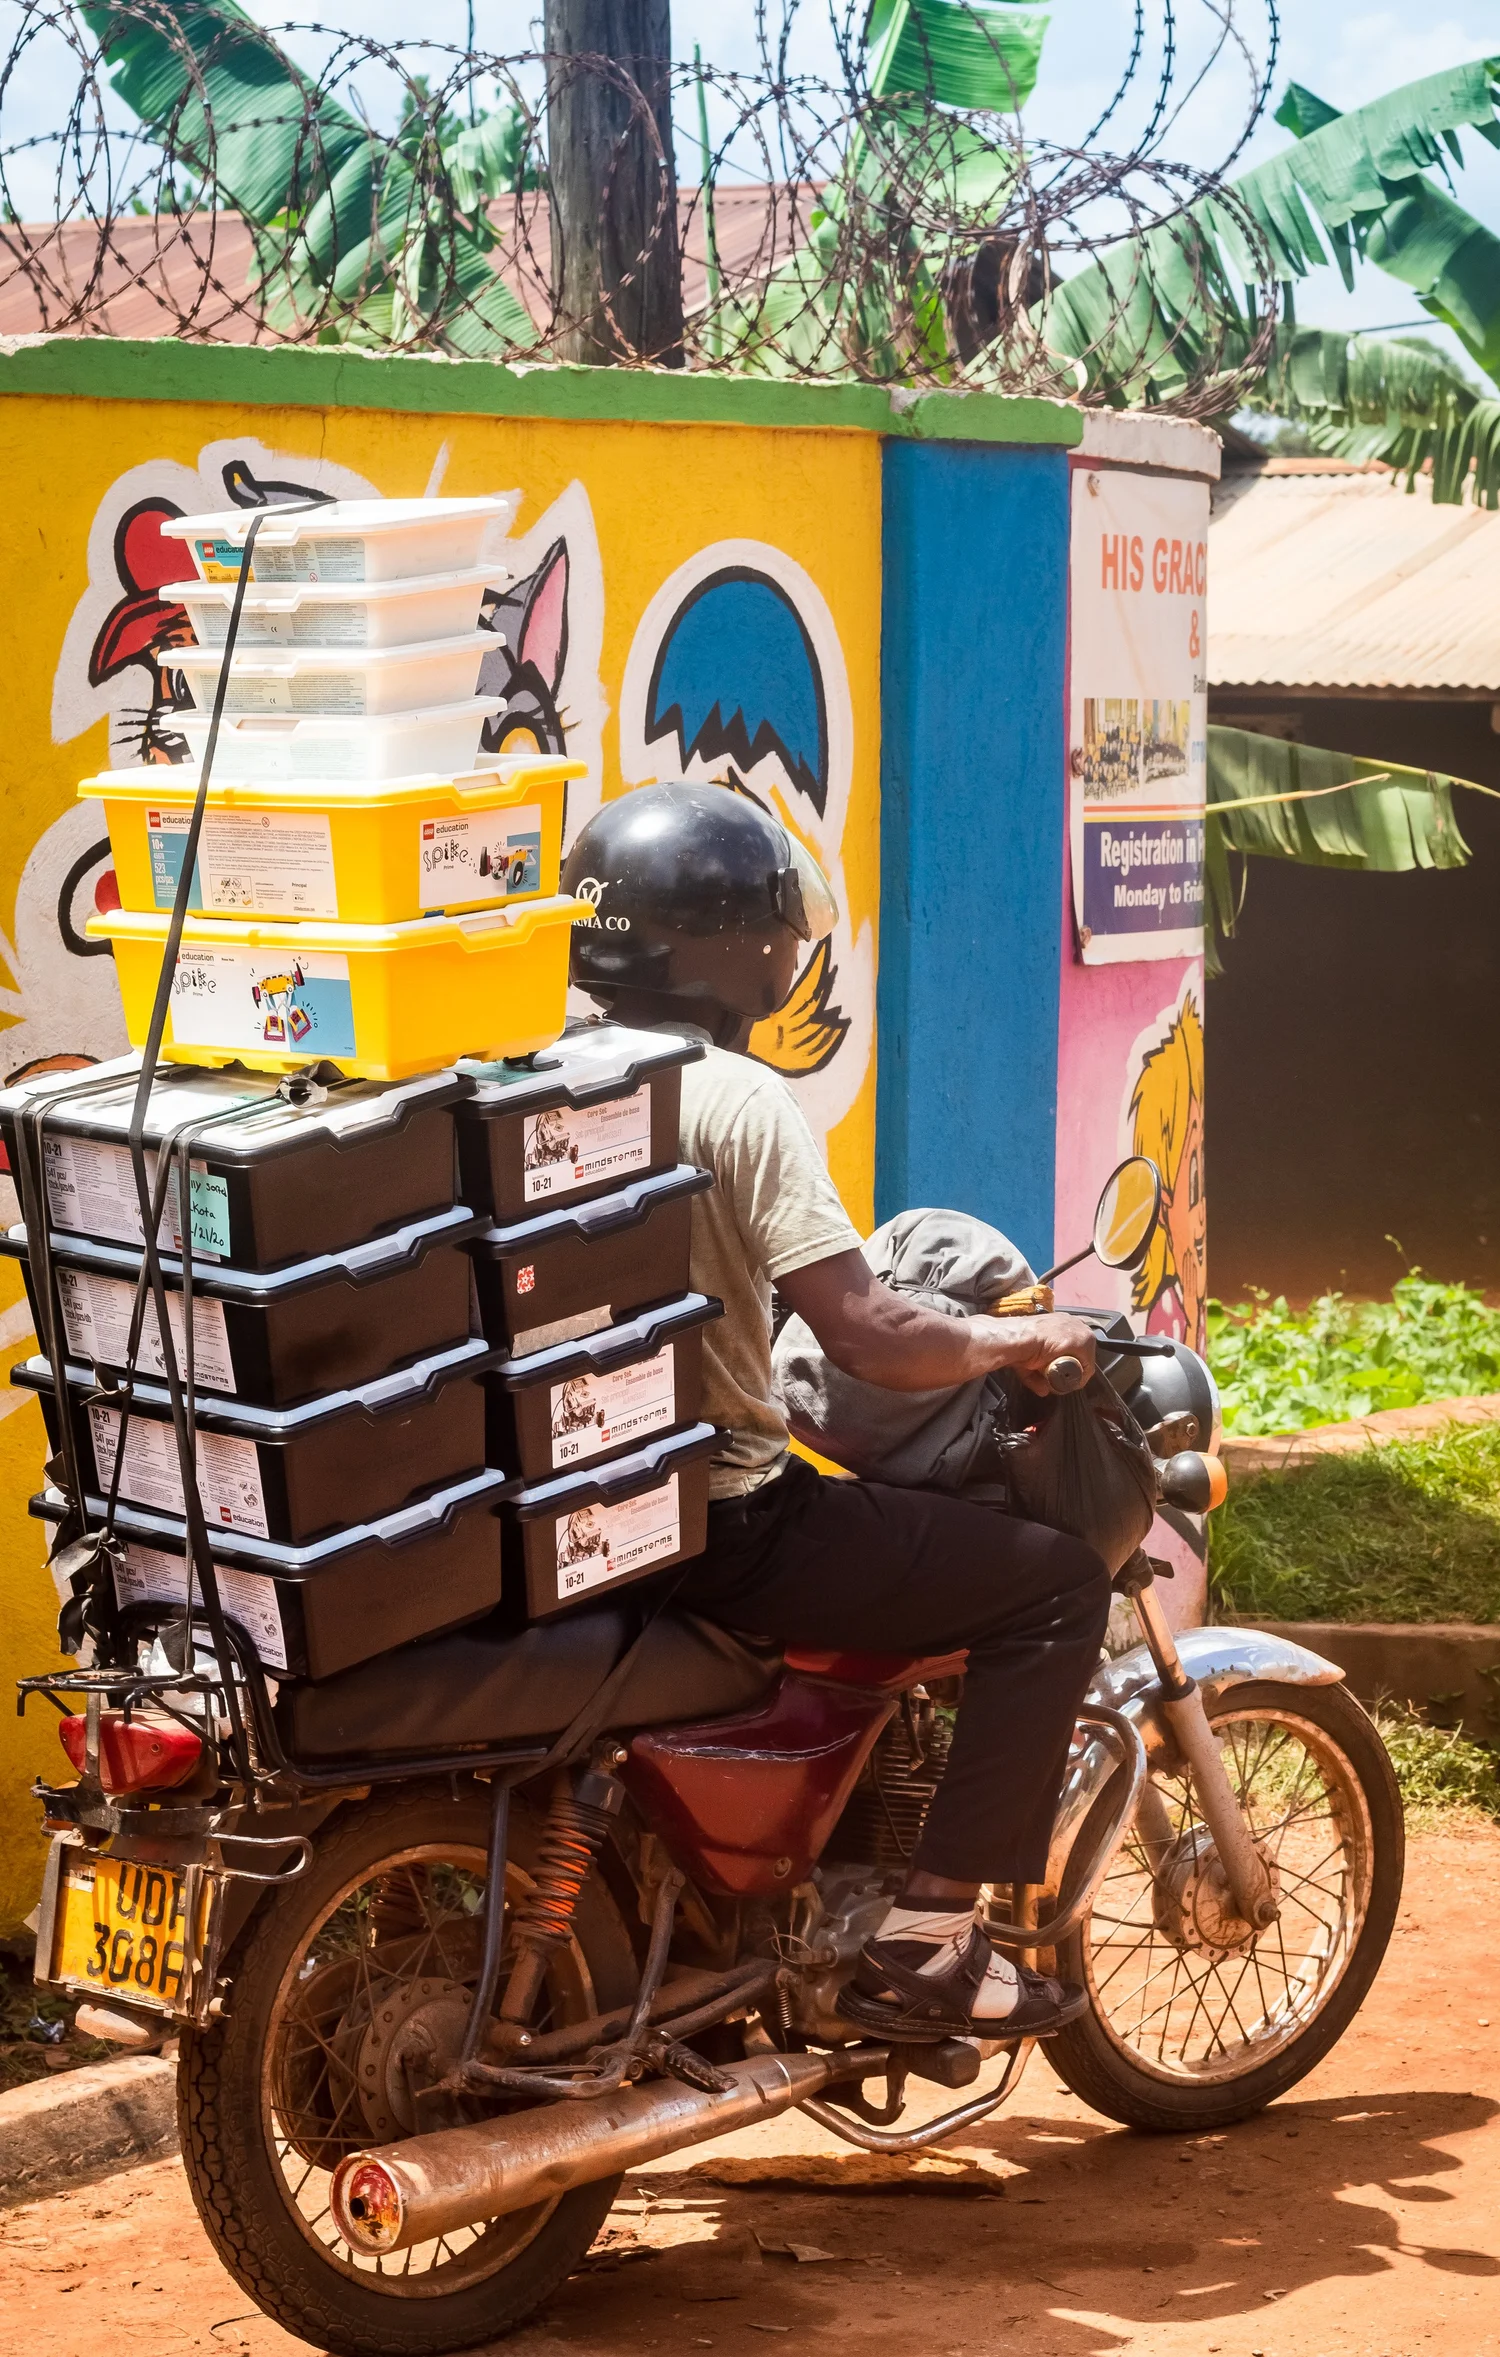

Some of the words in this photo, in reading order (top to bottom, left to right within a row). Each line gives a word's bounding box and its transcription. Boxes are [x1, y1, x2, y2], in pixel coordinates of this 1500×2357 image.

[1102, 534, 1144, 592] HIS
[1189, 609, 1200, 659] &
[162, 816, 193, 825] educatio
[436, 822, 469, 834] education
[152, 839, 164, 850] 10+
[1100, 830, 1184, 876] Registration
[1186, 829, 1197, 863] in
[1114, 883, 1166, 911] Monday
[1169, 882, 1181, 904] to
[605, 916, 631, 931] CO
[181, 952, 215, 962] education
[585, 1166, 607, 1176] education
[532, 1177, 552, 1193] 10-21
[91, 1408, 111, 1423] 10-21
[95, 1432, 104, 1443] 541
[560, 1443, 579, 1459] 10-21
[232, 1514, 265, 1528] education
[566, 1572, 584, 1588] 10-21
[257, 1643, 283, 1658] ducation
